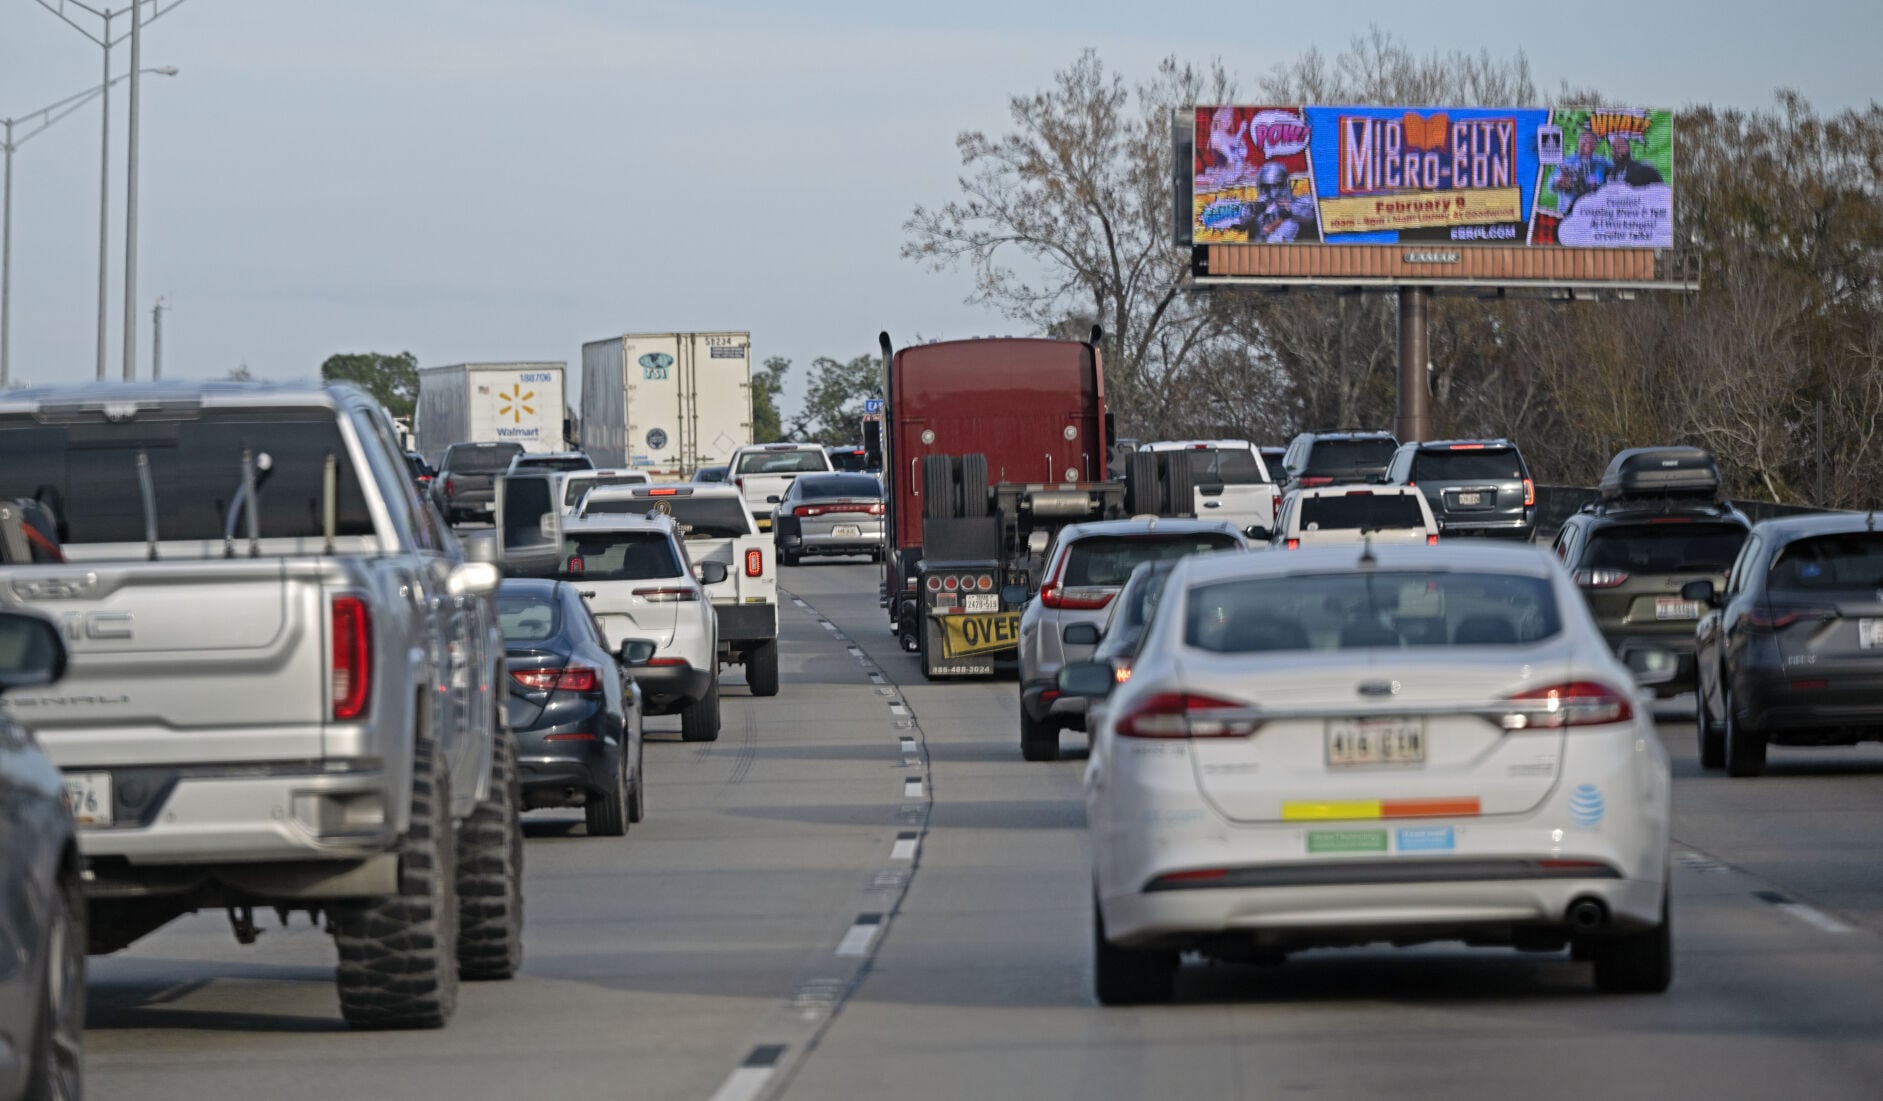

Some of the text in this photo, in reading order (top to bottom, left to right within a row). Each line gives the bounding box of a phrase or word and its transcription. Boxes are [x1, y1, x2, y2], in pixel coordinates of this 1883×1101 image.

[1256, 124, 1311, 149] POW!
[1346, 117, 1513, 156] MID CITY
[1346, 152, 1509, 190] MICRO-CON
[1375, 197, 1450, 214] February
[868, 402, 884, 411] EAS
[497, 427, 539, 436] Walmart
